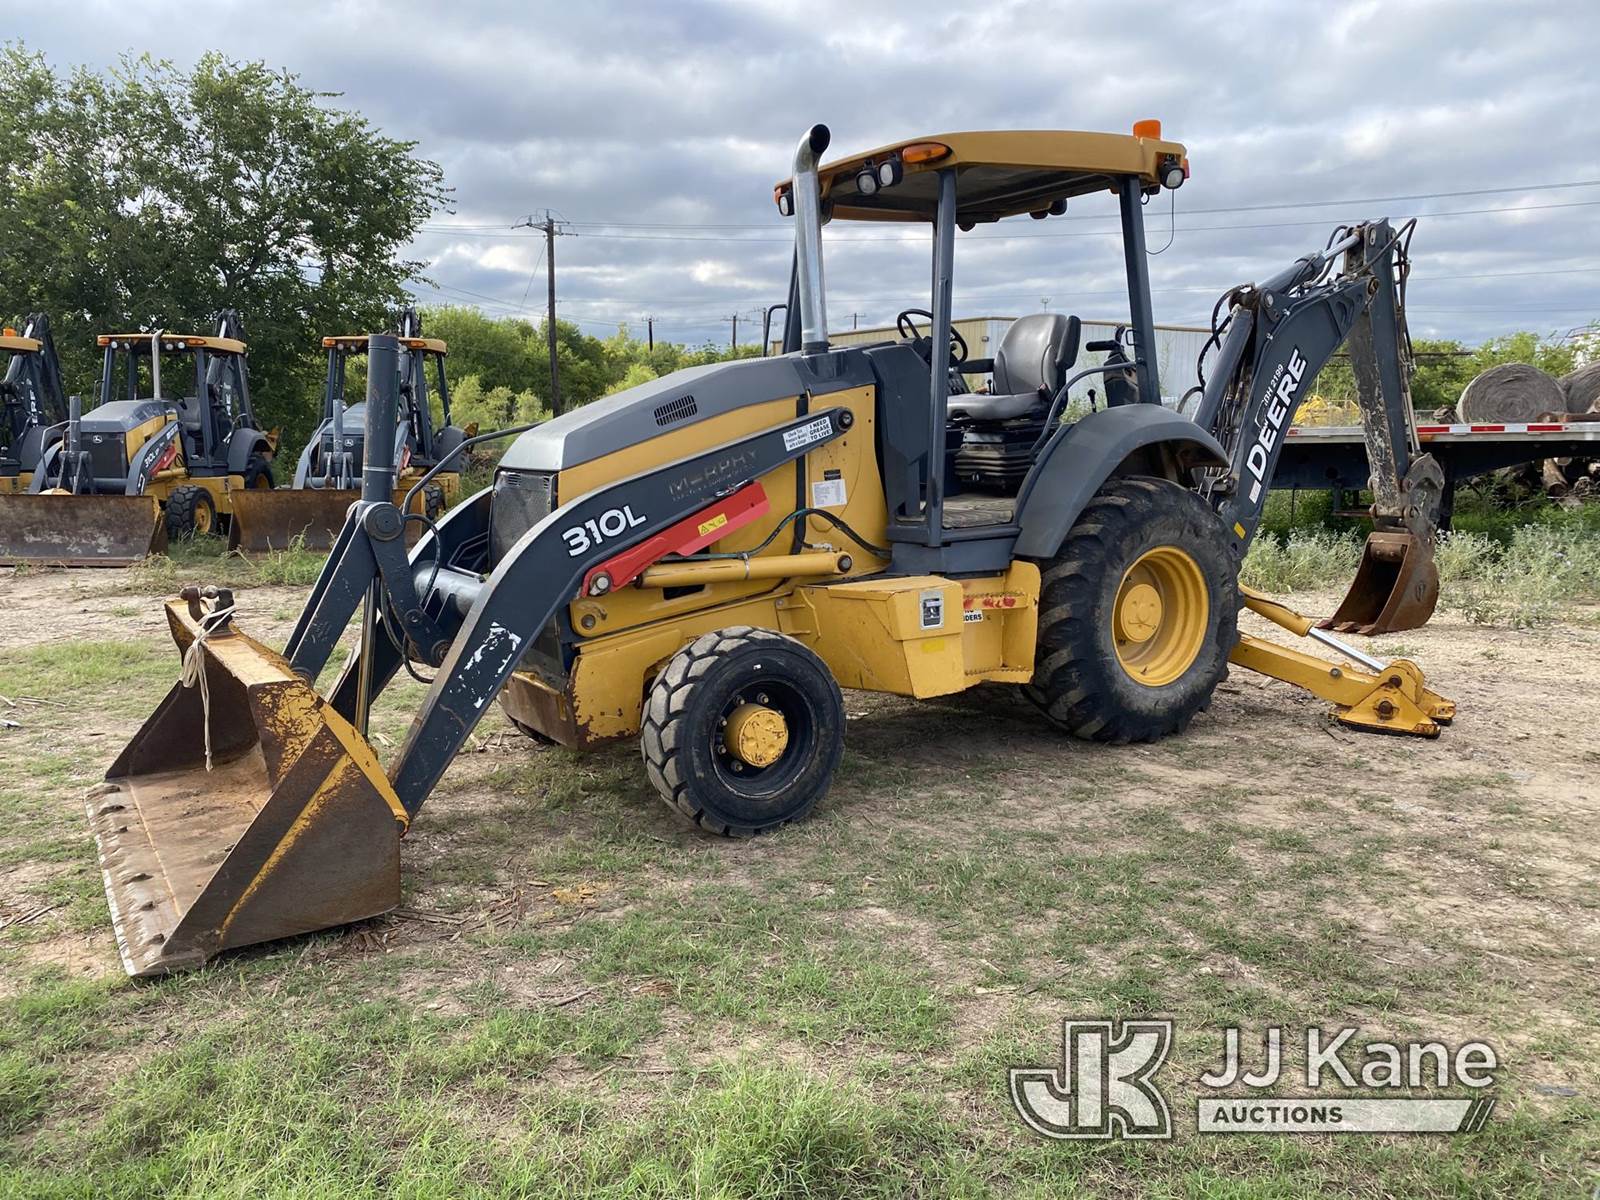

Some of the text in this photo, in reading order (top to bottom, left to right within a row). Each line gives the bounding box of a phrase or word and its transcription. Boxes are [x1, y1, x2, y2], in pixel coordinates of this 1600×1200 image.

[1270, 363, 1284, 388] 2199
[813, 419, 827, 428] NEED
[1247, 349, 1307, 482] DEERE
[809, 423, 830, 435] GREASE
[562, 505, 647, 557] 310L
